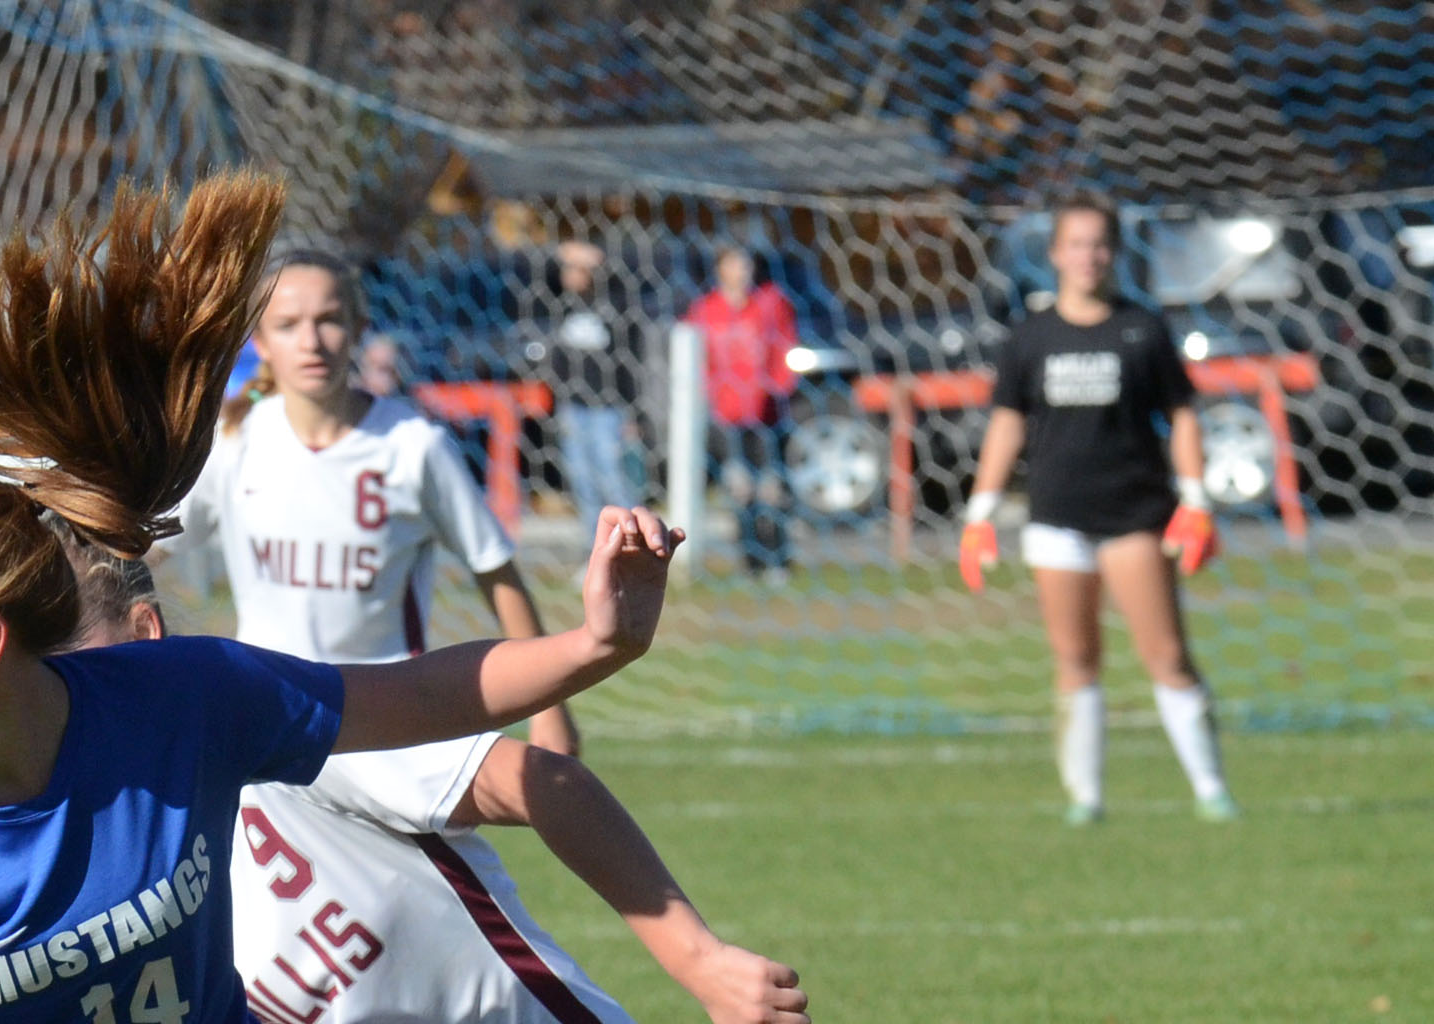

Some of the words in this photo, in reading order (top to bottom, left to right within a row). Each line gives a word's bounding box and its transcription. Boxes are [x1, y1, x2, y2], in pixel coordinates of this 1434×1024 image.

[355, 468, 389, 531] 6
[248, 535, 379, 593] MILLIS
[240, 806, 315, 901] 9
